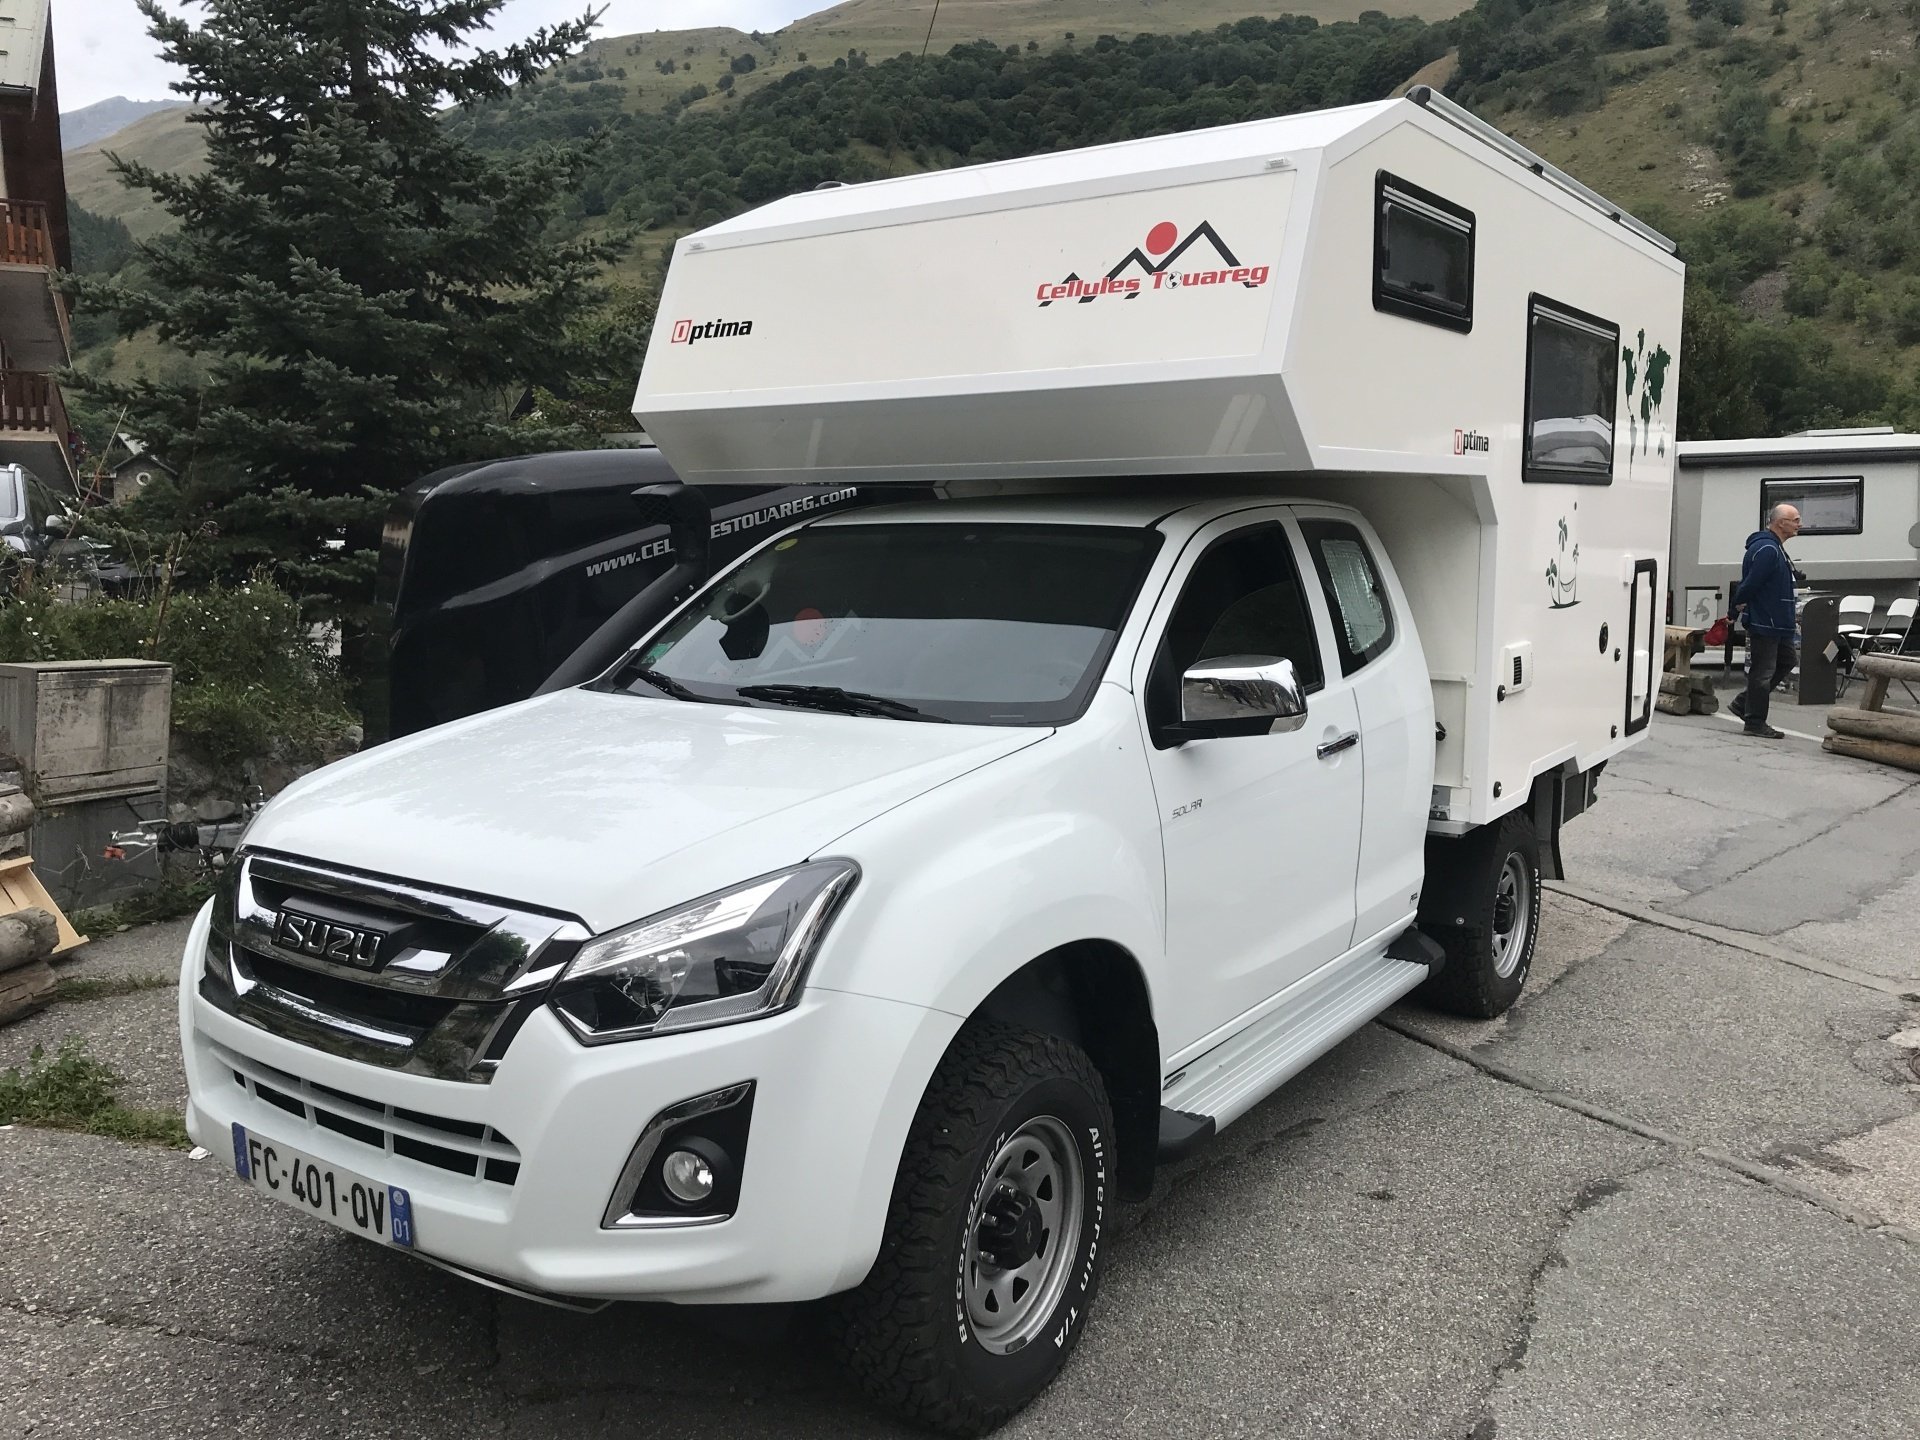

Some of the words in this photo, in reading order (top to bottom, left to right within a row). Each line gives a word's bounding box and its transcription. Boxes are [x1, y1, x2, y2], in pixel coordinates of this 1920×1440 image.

[1036, 277, 1141, 300] Cellules
[671, 318, 753, 345] Optima
[1453, 429, 1489, 456] Optima
[1172, 798, 1203, 820] SOLAR
[271, 912, 381, 967] ISUZU
[249, 1138, 385, 1235] FC-401-QV
[1081, 1127, 1106, 1292] All-Terrain
[393, 1217, 410, 1242] 01
